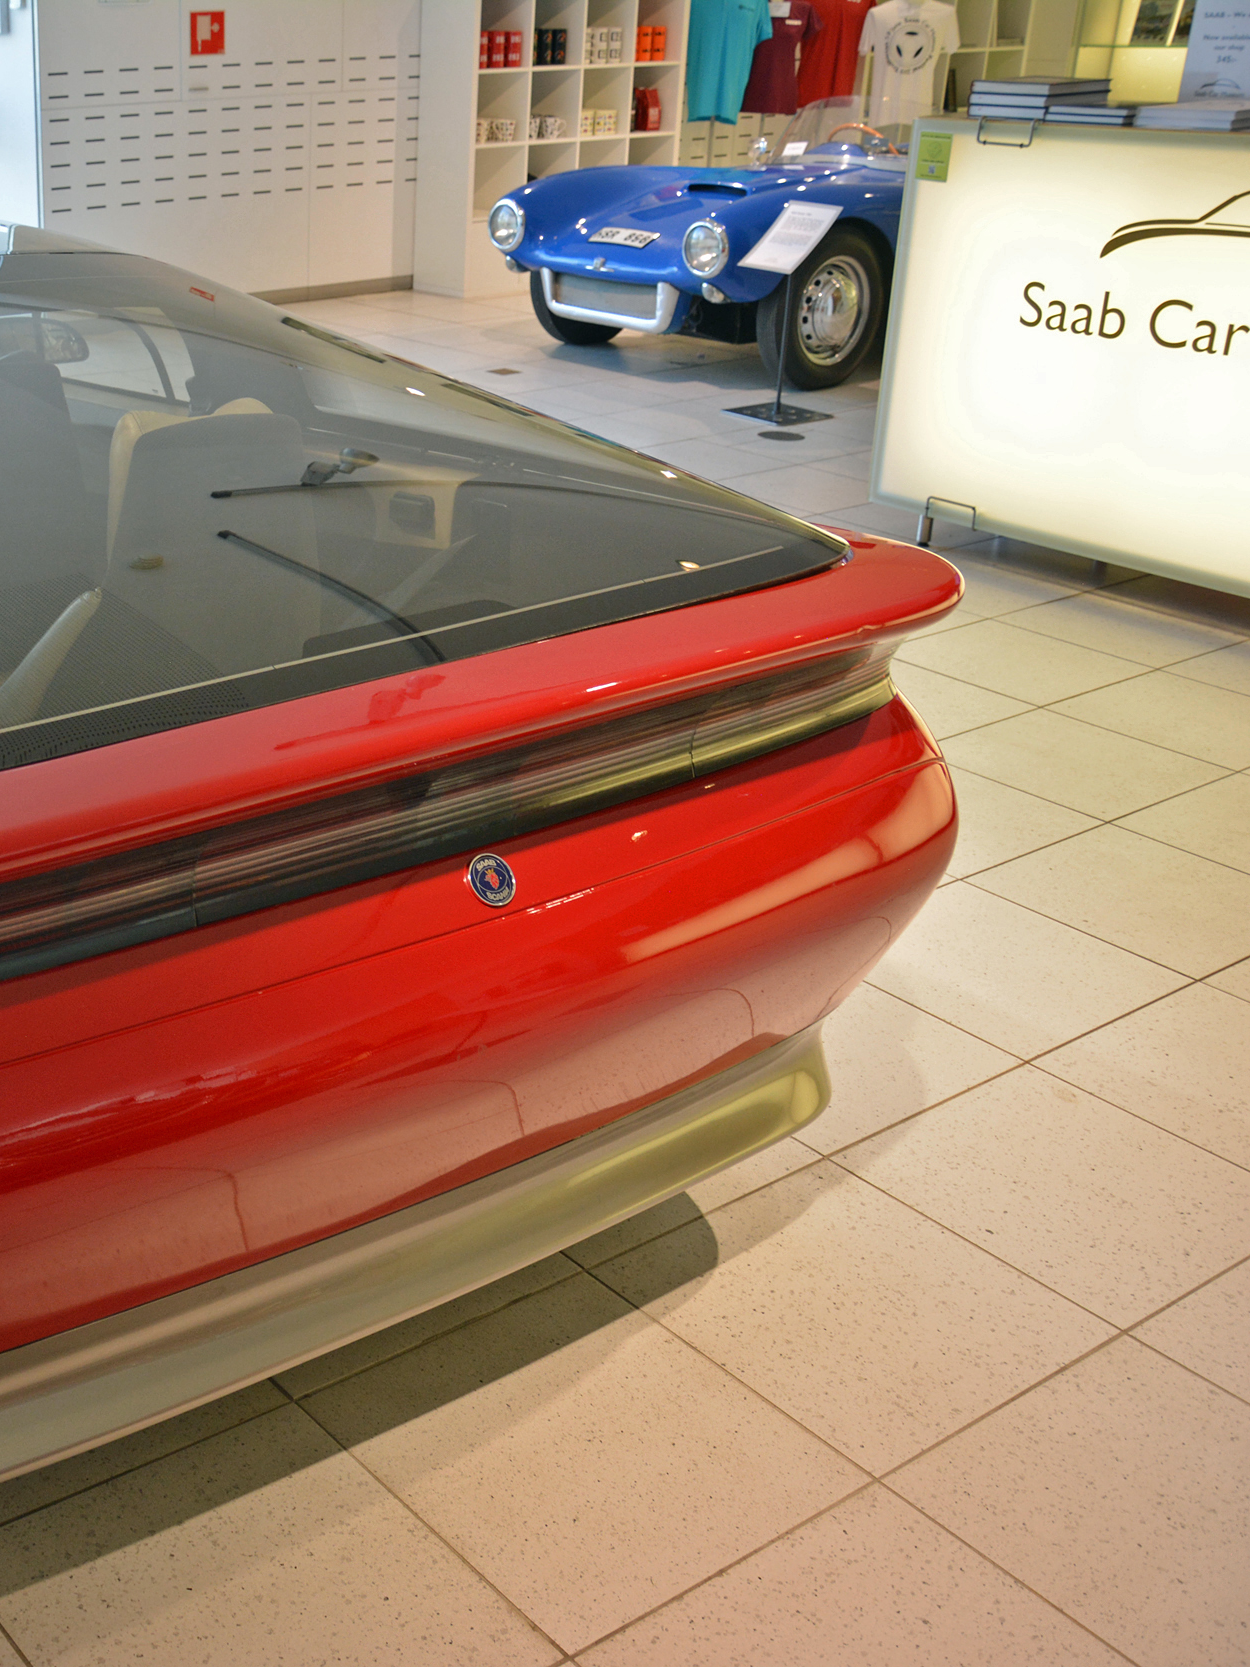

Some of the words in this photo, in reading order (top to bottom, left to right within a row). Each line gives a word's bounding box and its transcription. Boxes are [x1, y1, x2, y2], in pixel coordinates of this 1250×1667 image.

[1019, 281, 1126, 339] Saab
[1149, 299, 1250, 356] Car
[476, 858, 497, 871] SAAB
